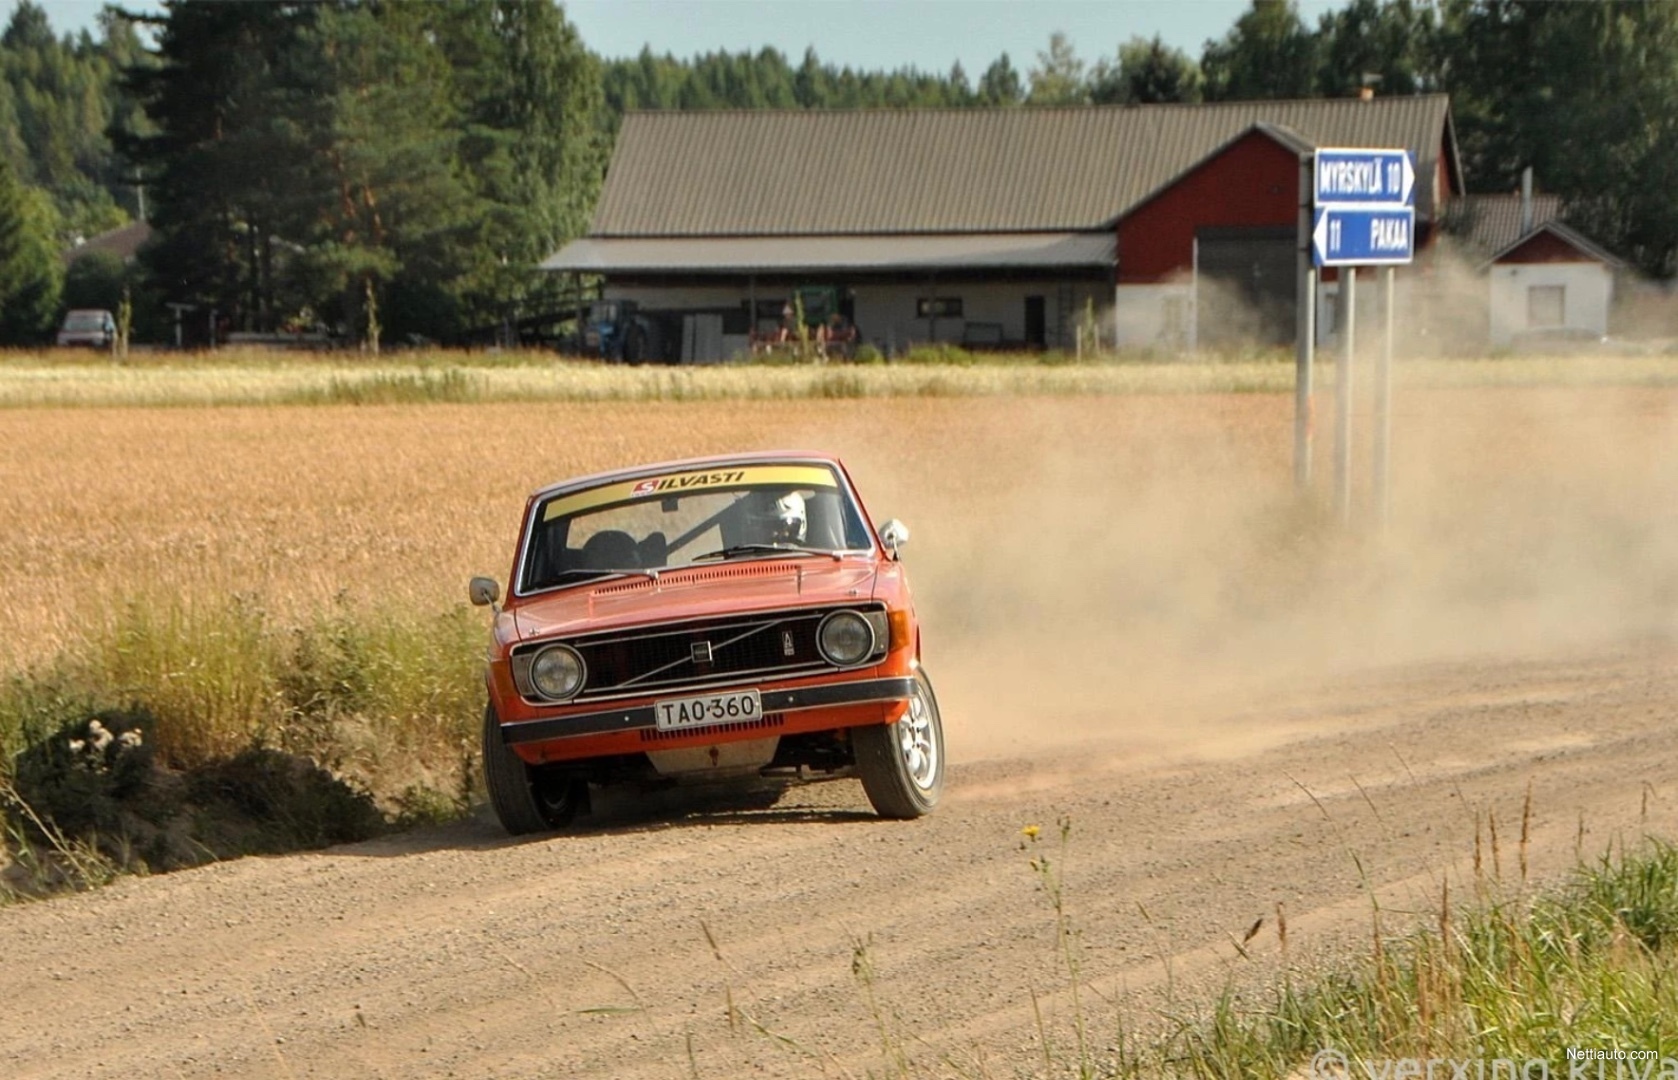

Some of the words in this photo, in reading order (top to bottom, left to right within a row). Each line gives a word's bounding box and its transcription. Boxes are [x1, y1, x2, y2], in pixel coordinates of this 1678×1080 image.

[1320, 156, 1383, 195] MYRSKYLÄ
[1387, 161, 1401, 195] 10
[1330, 219, 1341, 252] 11
[1370, 218, 1408, 251] PAKAA
[633, 471, 745, 492] SILVASTI
